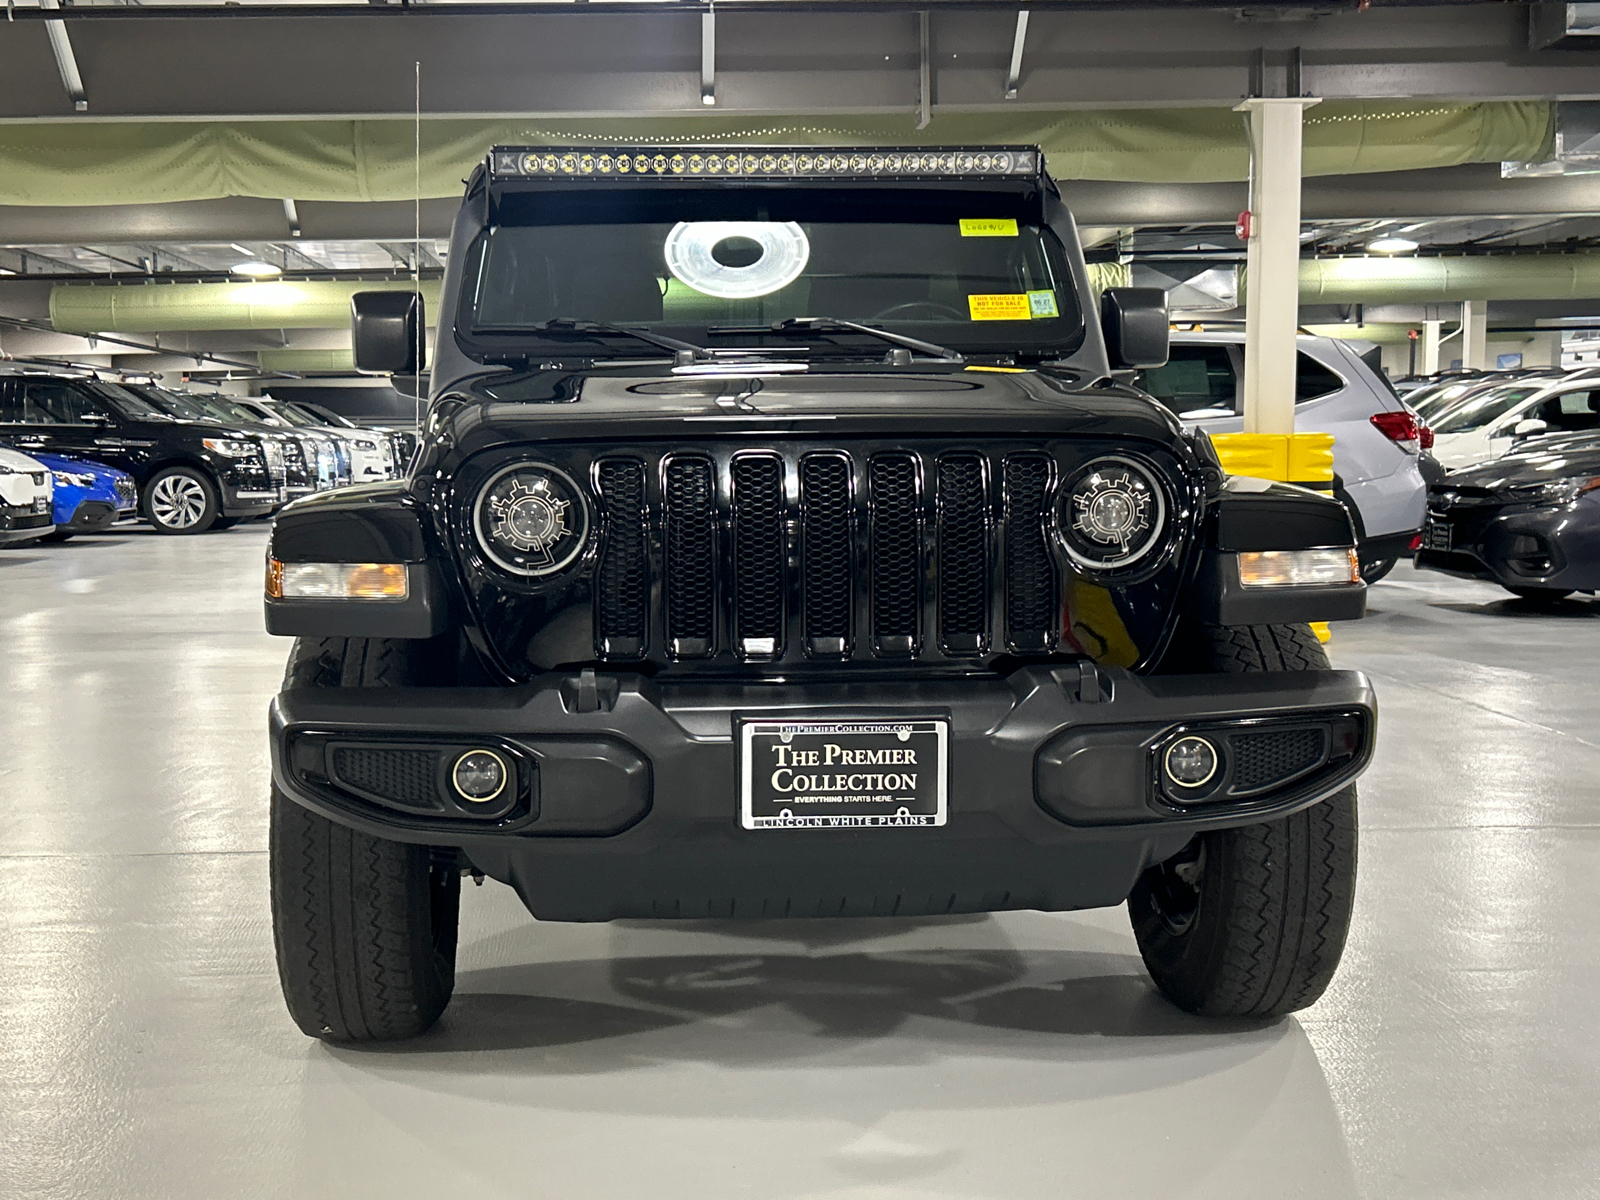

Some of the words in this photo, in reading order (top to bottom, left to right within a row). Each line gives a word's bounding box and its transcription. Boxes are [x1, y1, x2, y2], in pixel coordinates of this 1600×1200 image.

[771, 744, 820, 767] THE
[823, 744, 918, 766] PREMIER
[771, 768, 918, 792] COLLECTION
[794, 796, 843, 804] EVERYTHING
[844, 795, 871, 803] STARTS
[763, 818, 822, 828] LINCOLN
[829, 817, 872, 827] WHITE
[878, 816, 927, 826] PLAINS
